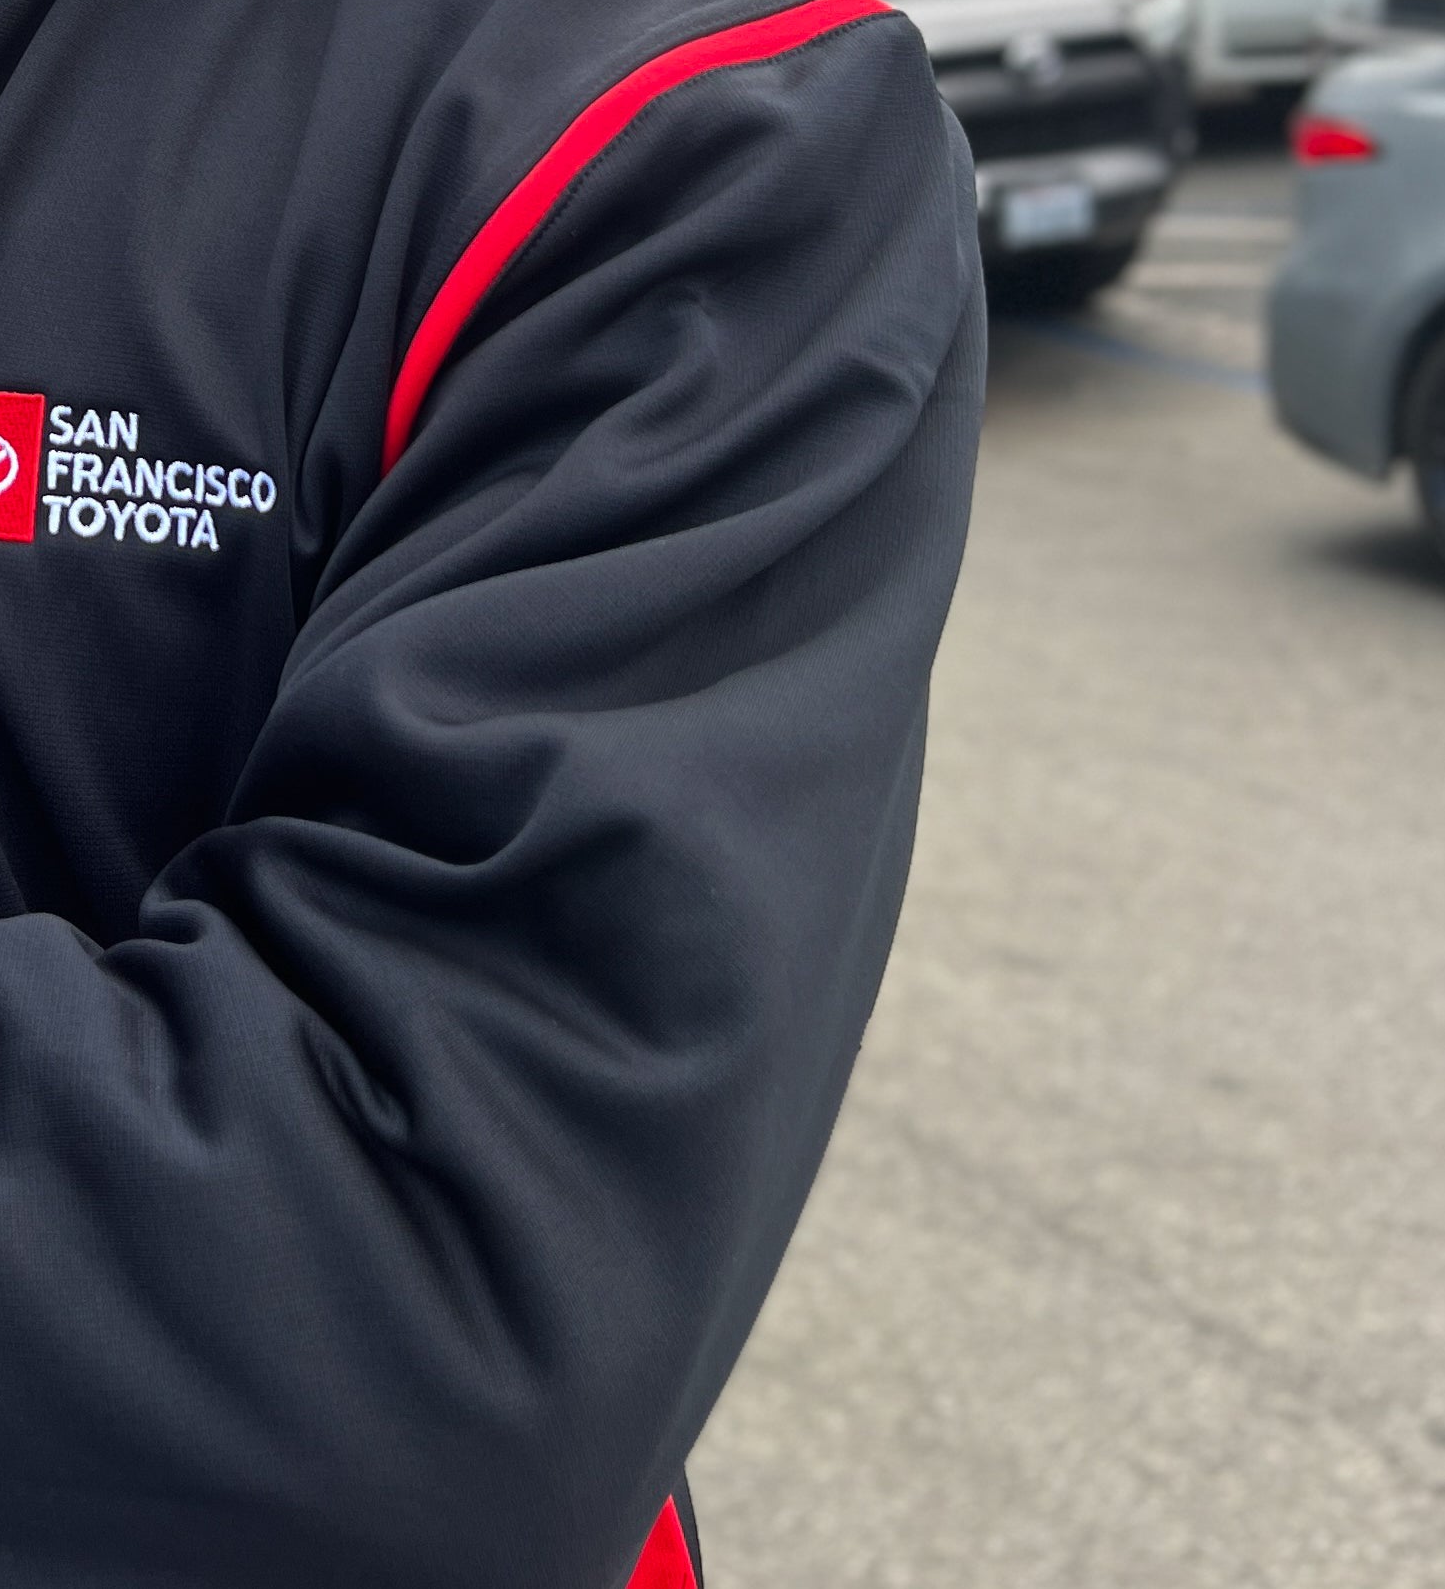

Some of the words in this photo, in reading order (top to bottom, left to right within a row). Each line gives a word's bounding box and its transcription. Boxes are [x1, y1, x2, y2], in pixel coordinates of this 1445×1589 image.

[49, 405, 139, 452] SAN
[47, 449, 278, 513] FRANCISCO
[42, 494, 220, 552] TOYOTA
